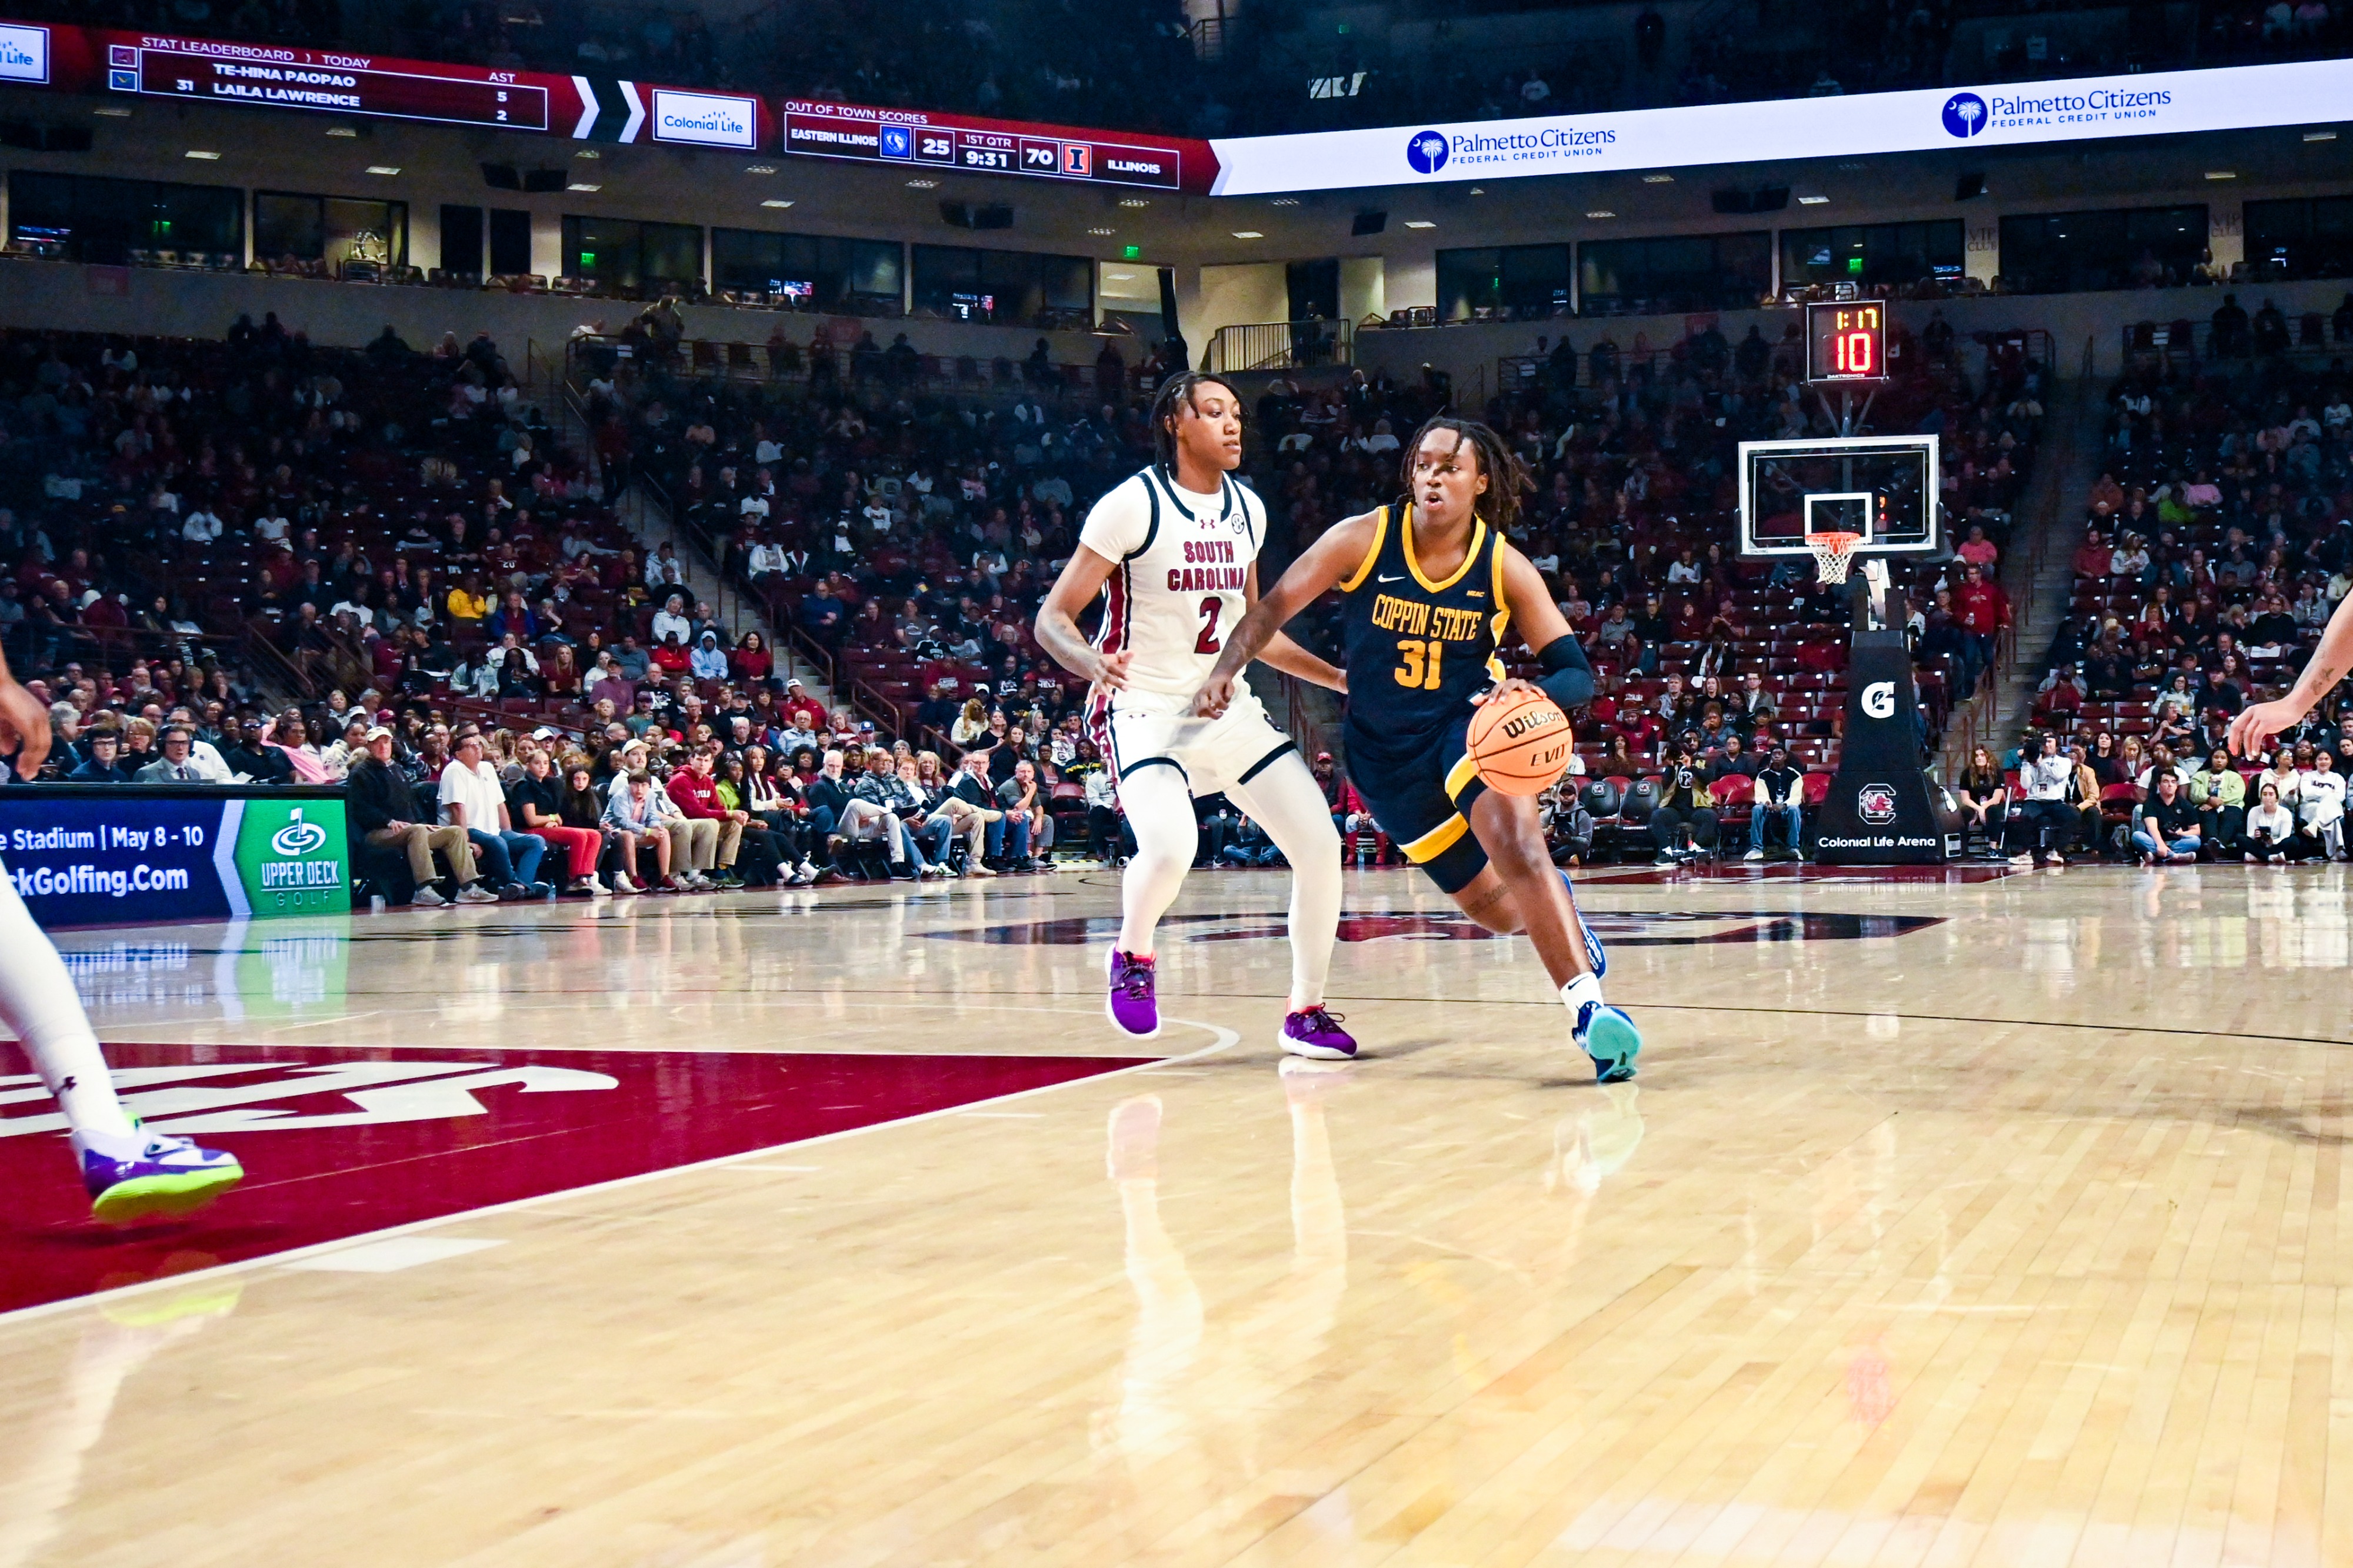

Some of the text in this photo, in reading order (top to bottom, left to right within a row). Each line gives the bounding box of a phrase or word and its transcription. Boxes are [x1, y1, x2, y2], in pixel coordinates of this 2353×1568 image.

[7, 49, 34, 65] Life
[142, 36, 370, 68] STAT LEADERBOARD TODAY
[212, 63, 356, 87] TE-HINA PAOPAO
[489, 72, 515, 83] AST
[176, 79, 360, 106] 31 LAILA LAWRENCE
[497, 91, 508, 102] 5
[1992, 89, 2171, 116] Palmetto Citizens
[496, 110, 507, 121] 2
[664, 115, 743, 133] Colonial Life
[785, 102, 928, 124] OUT OF TOWN SCORES
[1992, 110, 2156, 127] FEDERAL CREDIT UNION
[791, 129, 878, 146] EASTERN ILLINOIS
[922, 138, 950, 155] 25
[965, 135, 1011, 147] 1ST QTR
[1452, 128, 1616, 153] Palmetto Citizens
[966, 151, 1007, 168] 9:31
[1026, 148, 1054, 165] 70
[1108, 159, 1161, 174] ILLINOIS
[1452, 148, 1602, 164] FEDERAL CREDIT UNION
[1837, 308, 1877, 330] 1:17
[1838, 333, 1871, 372] 10
[1184, 541, 1234, 563] SOUTH
[1167, 568, 1244, 592] CAROLINA
[1194, 596, 1222, 655] 2
[1372, 593, 1482, 640] COPPIN STATE
[1394, 639, 1442, 690] 31
[1502, 710, 1564, 739] Wilson
[13, 827, 95, 850] Stadium
[112, 827, 149, 850] May
[154, 826, 166, 846] 8
[182, 826, 204, 846] 10
[1818, 836, 1936, 848] Colonial Life Arena
[262, 860, 339, 886] UPPER DECK
[276, 890, 329, 906] GOLF
